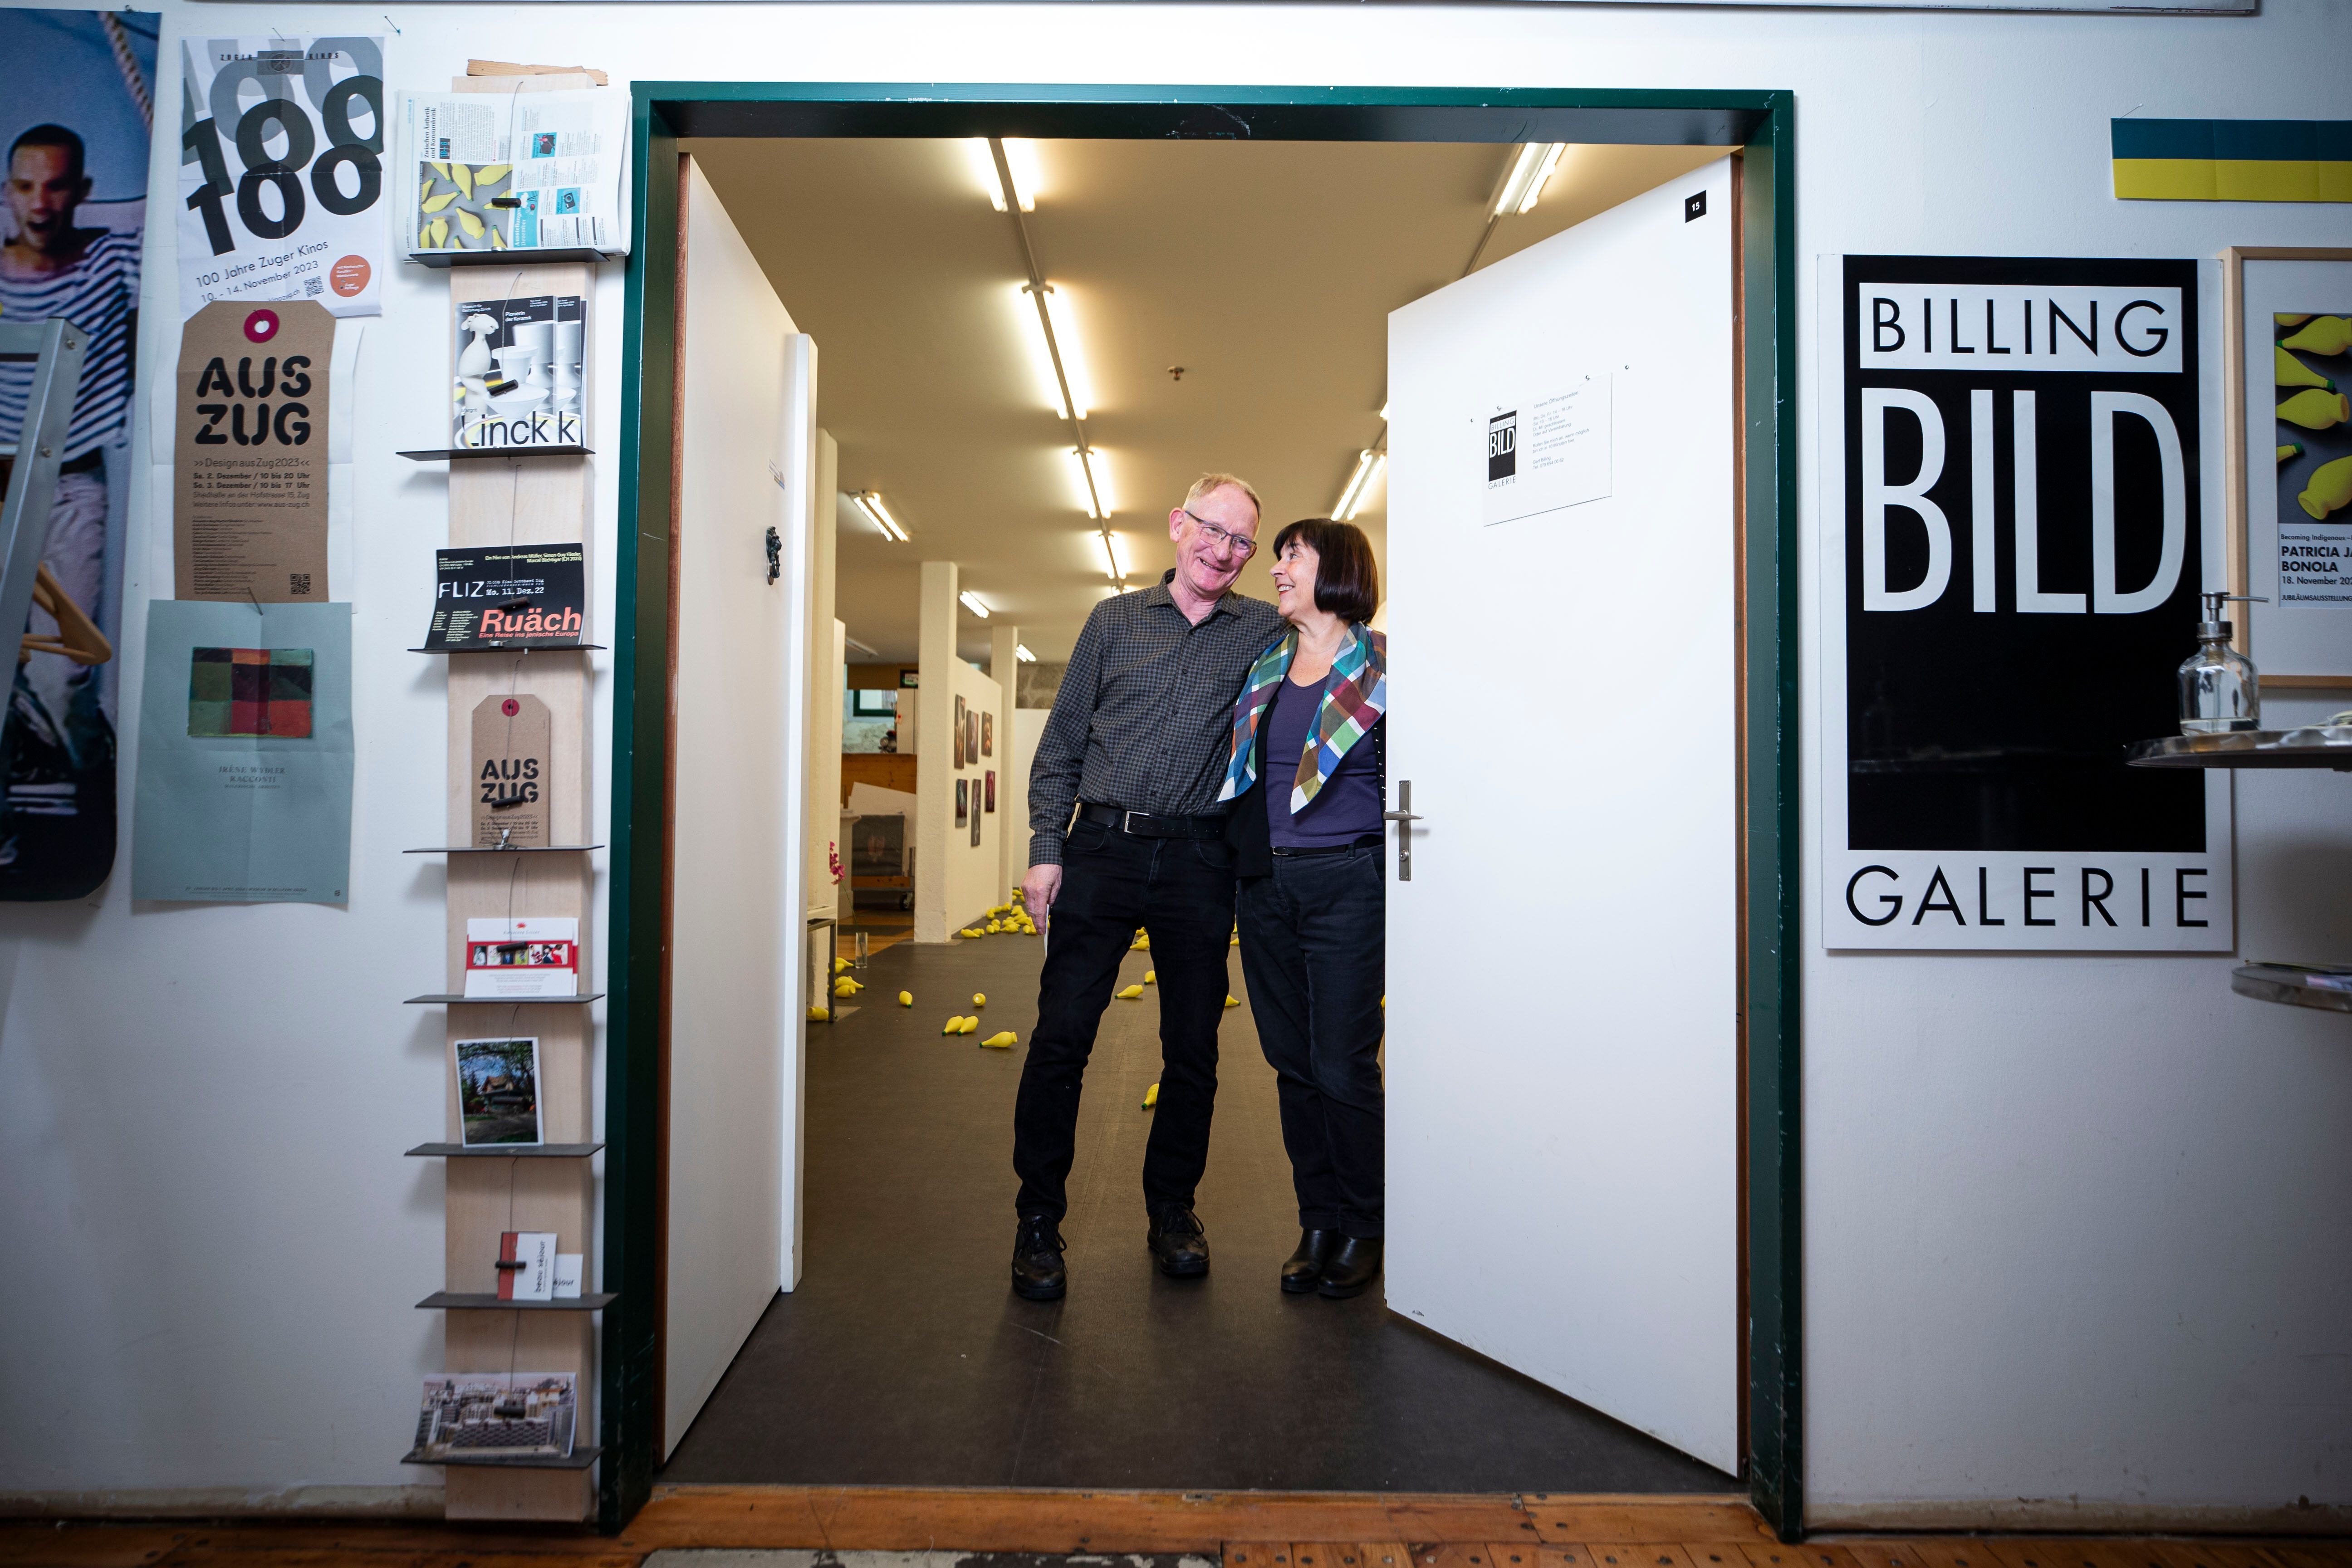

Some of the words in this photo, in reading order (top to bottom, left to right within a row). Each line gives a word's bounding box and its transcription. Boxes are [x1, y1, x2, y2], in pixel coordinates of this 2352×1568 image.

[186, 144, 382, 256] 100
[1692, 201, 1700, 212] 15
[196, 272, 219, 287] 100
[225, 264, 255, 279] Jahre
[258, 253, 294, 267] Zuger
[298, 241, 328, 257] Kinos
[226, 286, 242, 295] 14.
[244, 272, 291, 290] November
[294, 260, 318, 274] 2023
[1873, 297, 2169, 357] BILLING
[196, 355, 311, 398] AUS
[195, 402, 310, 446] ZUG
[1491, 418, 1514, 431] BILLING
[1490, 427, 1515, 458] BILD
[1488, 476, 1516, 490] GALERIE
[1862, 387, 2186, 614] BILD
[2281, 546, 2340, 557] PATRICIA
[2281, 561, 2339, 572] BONOLA
[438, 581, 485, 598] FLIZ
[2297, 576, 2337, 584] November
[480, 607, 582, 632] Ruäch
[480, 758, 539, 780] AUS
[480, 782, 539, 804] ZUG
[1846, 864, 2209, 927] GALERIE
